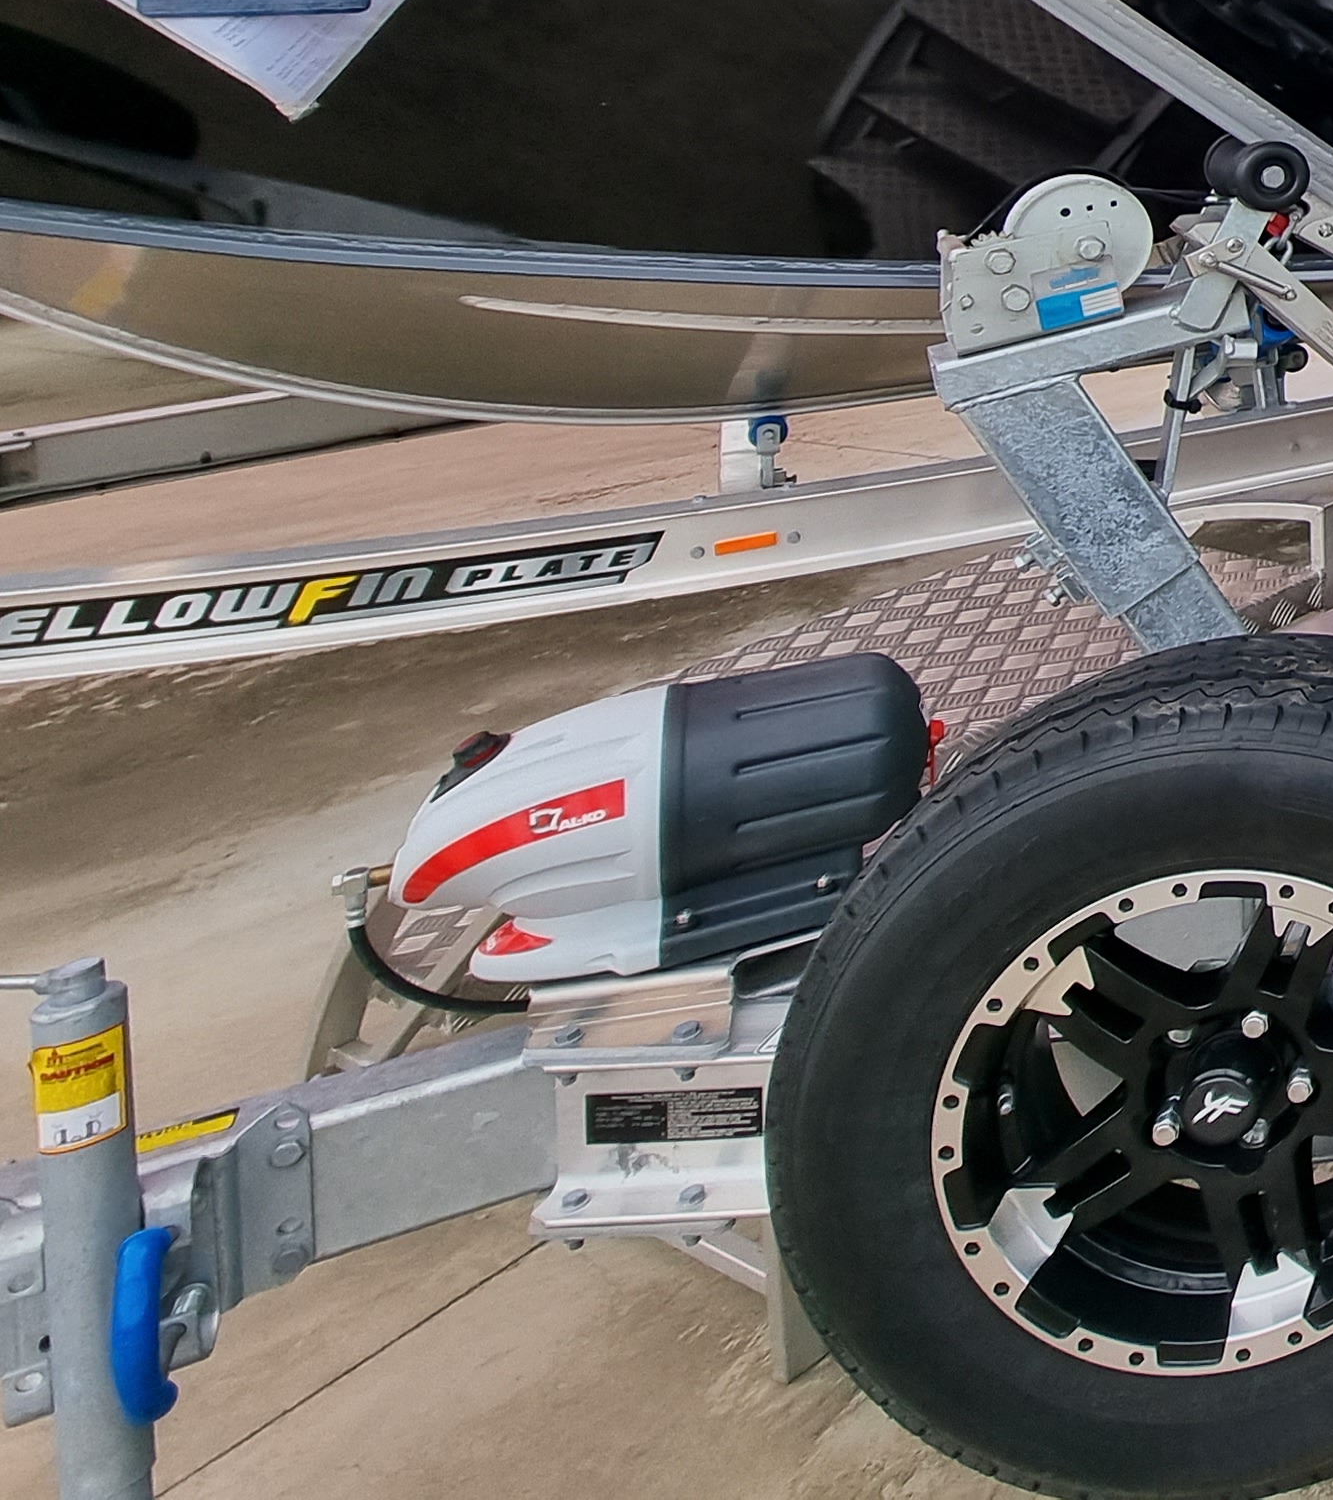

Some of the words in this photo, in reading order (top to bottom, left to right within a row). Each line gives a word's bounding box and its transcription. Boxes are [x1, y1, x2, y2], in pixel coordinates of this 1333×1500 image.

[0, 567, 432, 642] ELLOWFIN
[467, 546, 640, 589] PLATE
[557, 809, 607, 833] AL-KO
